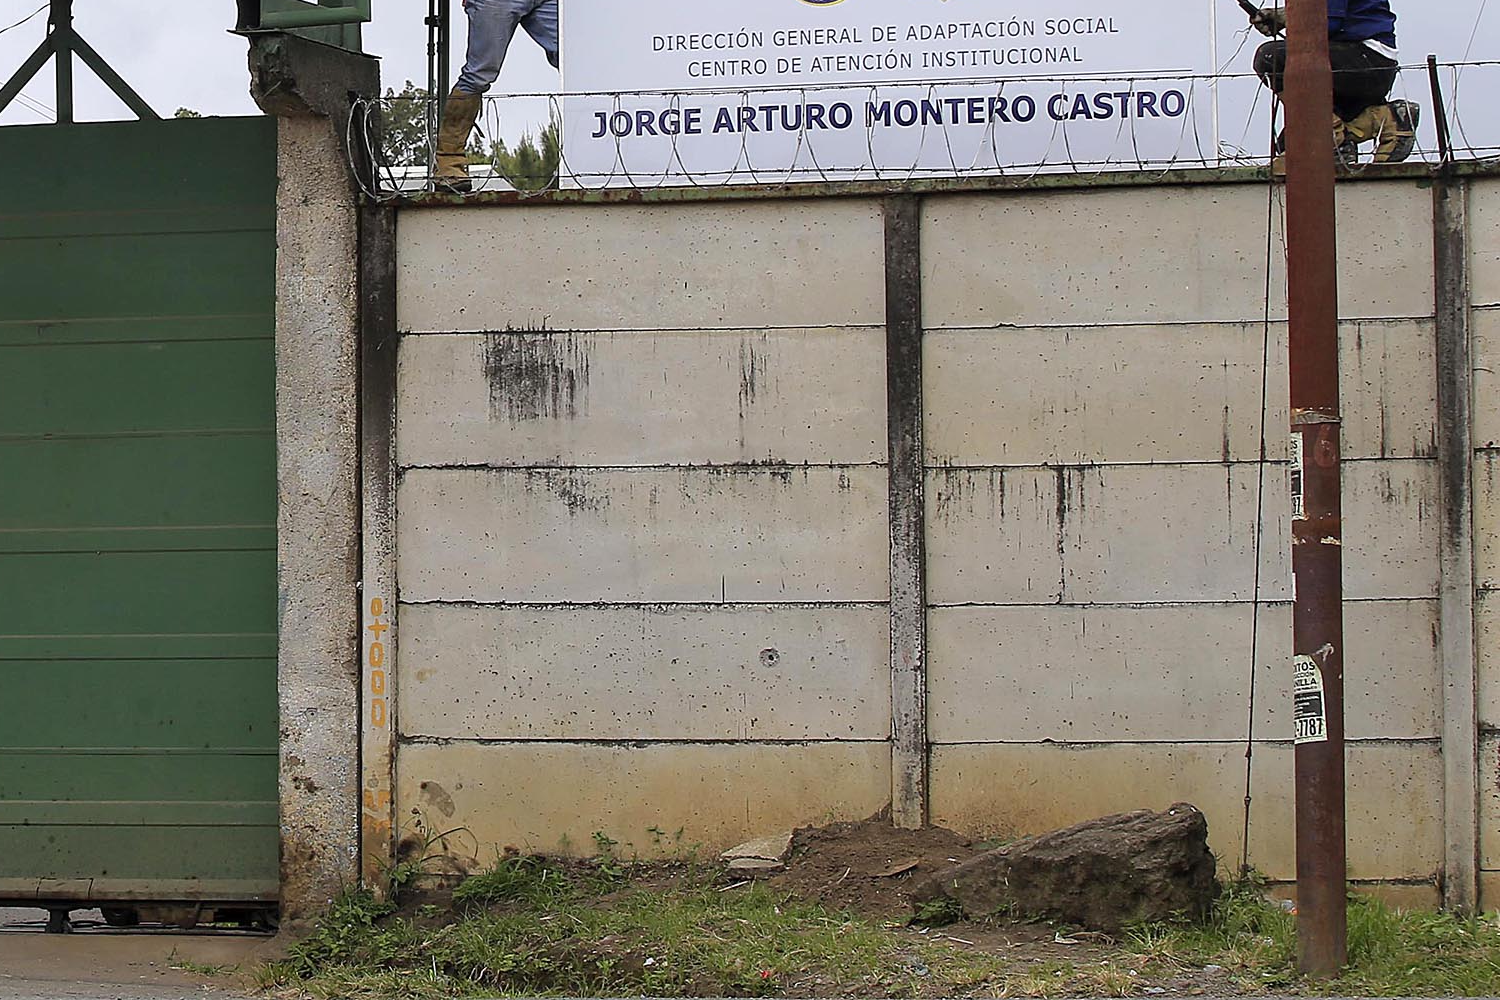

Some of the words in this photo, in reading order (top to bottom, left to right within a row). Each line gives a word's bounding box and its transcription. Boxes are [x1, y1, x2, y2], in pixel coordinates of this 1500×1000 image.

[652, 27, 763, 51] DIRECCIÓN
[773, 27, 863, 47] GENERAL
[872, 25, 897, 42] DE
[906, 16, 1035, 41] ADAPTACIÓN
[1045, 17, 1119, 36] SOCIAL
[688, 59, 767, 77] CENTRO
[777, 57, 802, 74] DE
[811, 48, 912, 72] ATENCIÓN
[922, 46, 1083, 68] INSTITUCIONAL
[592, 108, 702, 138] JORGE
[712, 101, 852, 133] ARTURO
[865, 95, 1036, 128] MONTERO
[1047, 90, 1185, 122] CASTRO
